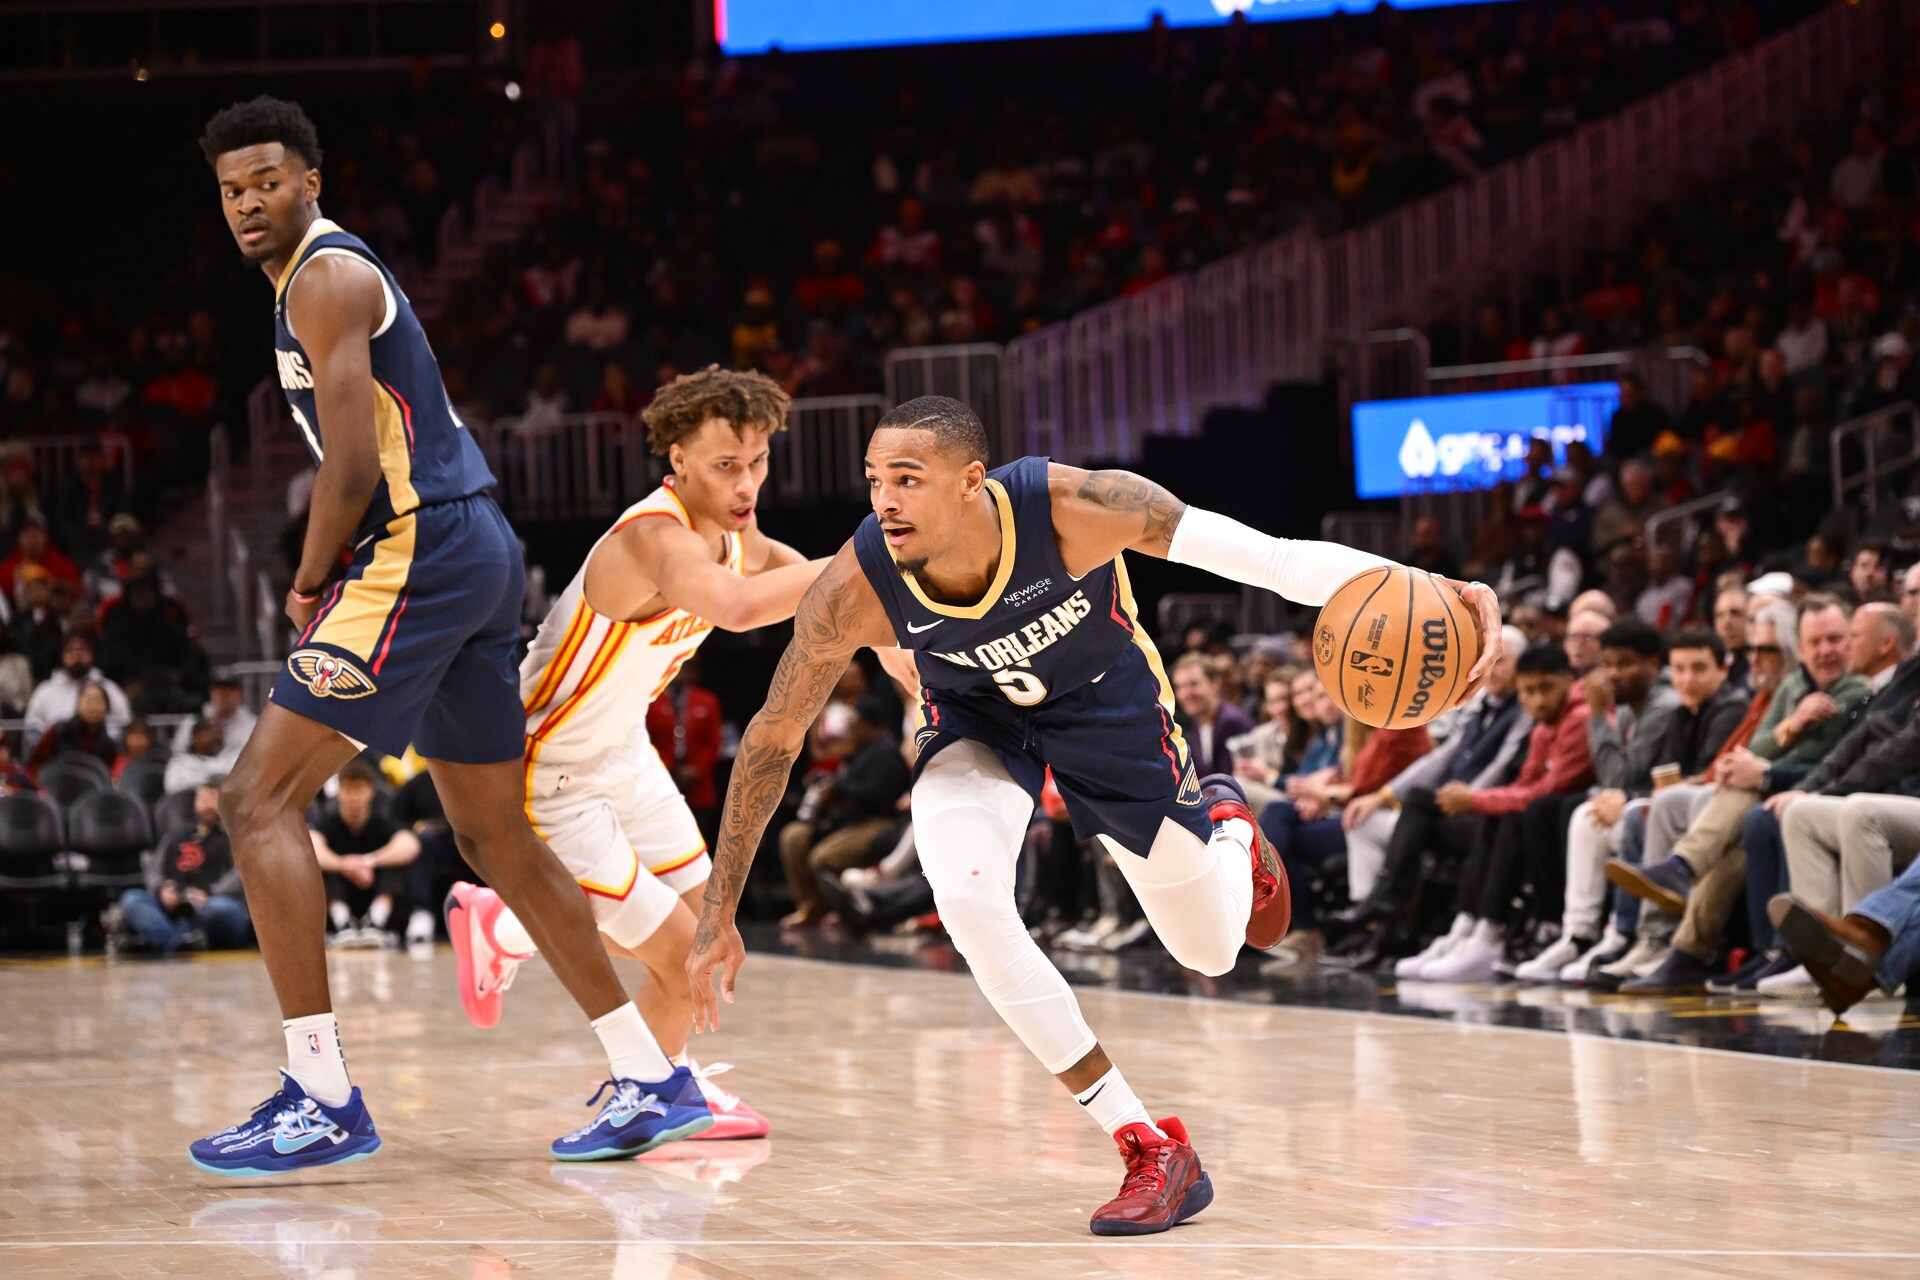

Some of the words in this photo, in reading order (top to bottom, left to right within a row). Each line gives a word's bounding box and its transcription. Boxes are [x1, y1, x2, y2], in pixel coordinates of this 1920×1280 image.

[1003, 577, 1053, 605] NEWAGE
[1014, 586, 1050, 608] GARAGE
[974, 588, 1092, 671] ORLEANS
[992, 657, 1048, 707] 5
[1400, 616, 1448, 719] Wilson
